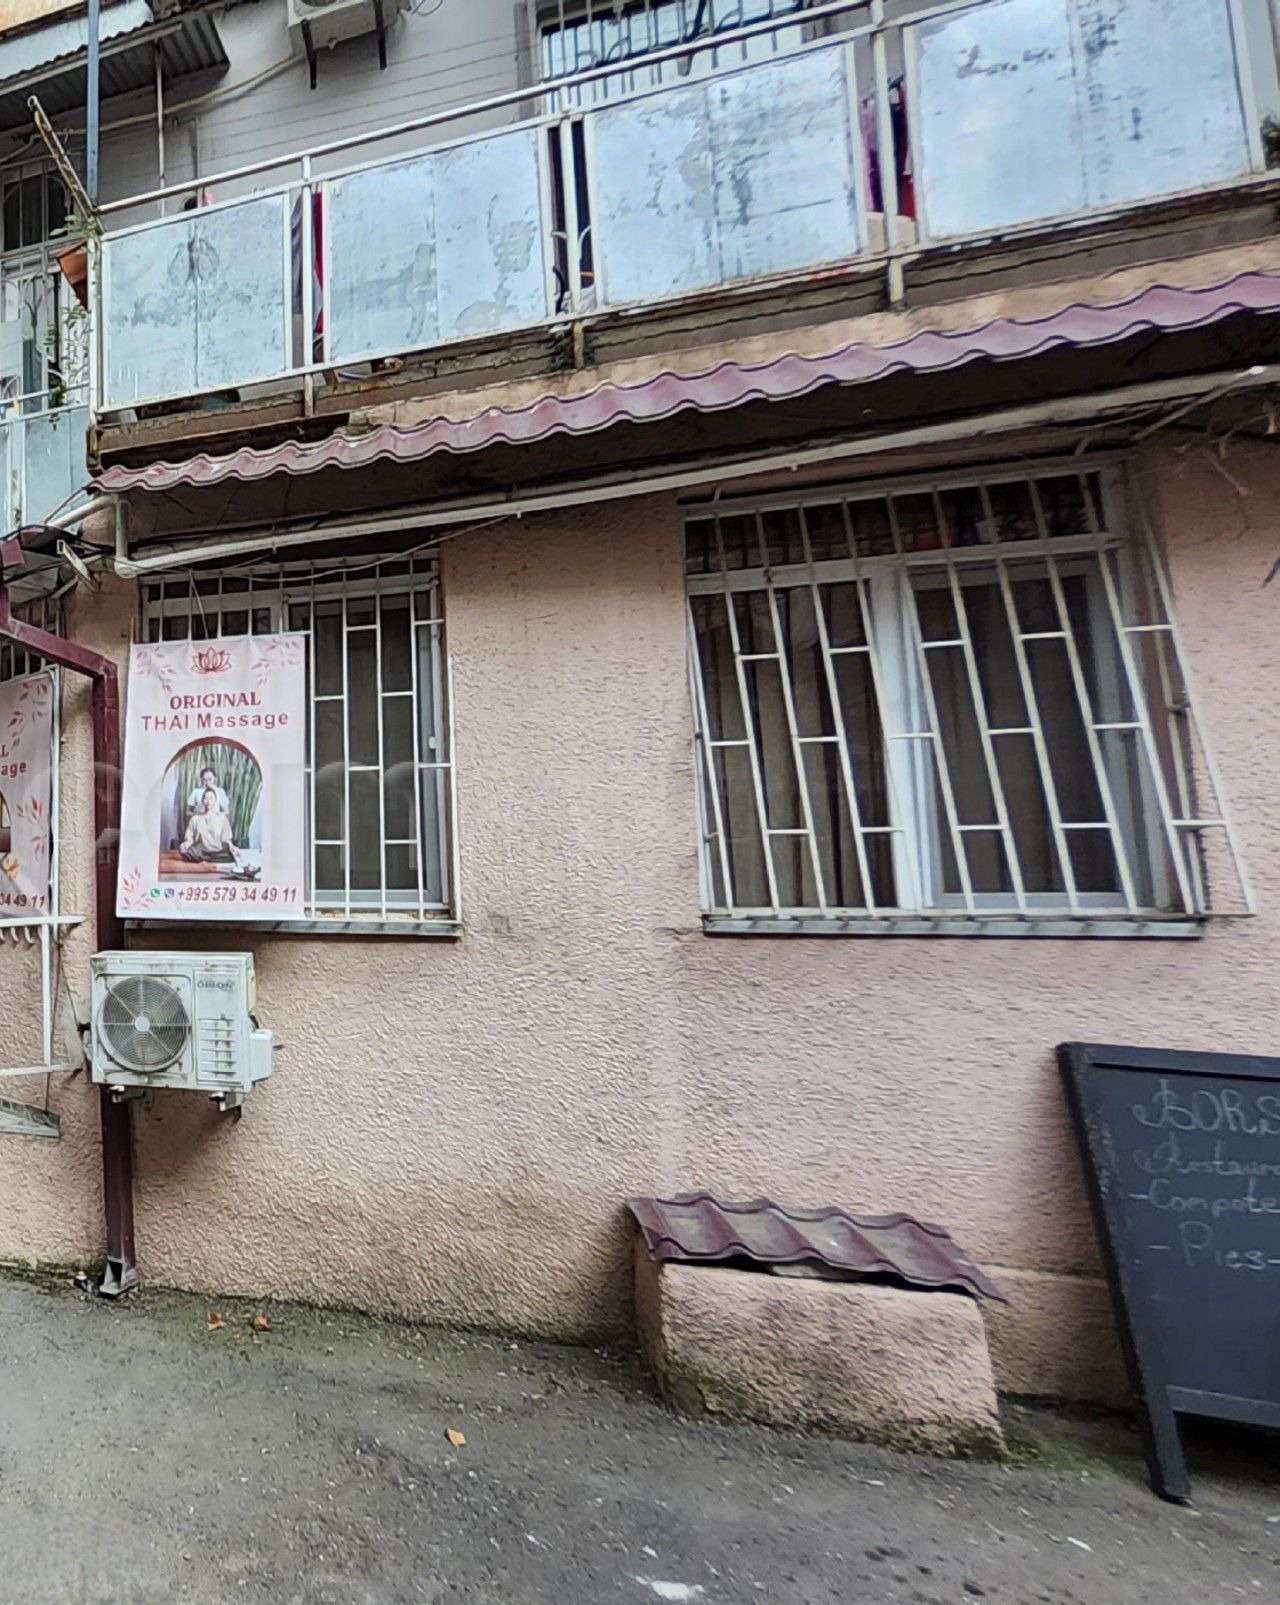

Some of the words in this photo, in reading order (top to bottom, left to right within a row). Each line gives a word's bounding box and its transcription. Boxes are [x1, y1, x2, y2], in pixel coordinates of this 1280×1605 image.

[170, 691, 261, 710] ORIGINAL
[141, 714, 189, 731] THAI
[197, 712, 289, 730] Massage
[0, 892, 11, 906] 34
[13, 894, 27, 907] 49
[31, 894, 46, 908] 11
[177, 886, 211, 901] +995
[212, 886, 237, 901] 579
[241, 887, 256, 901] 34
[261, 887, 278, 902] 49
[282, 887, 297, 903] 11
